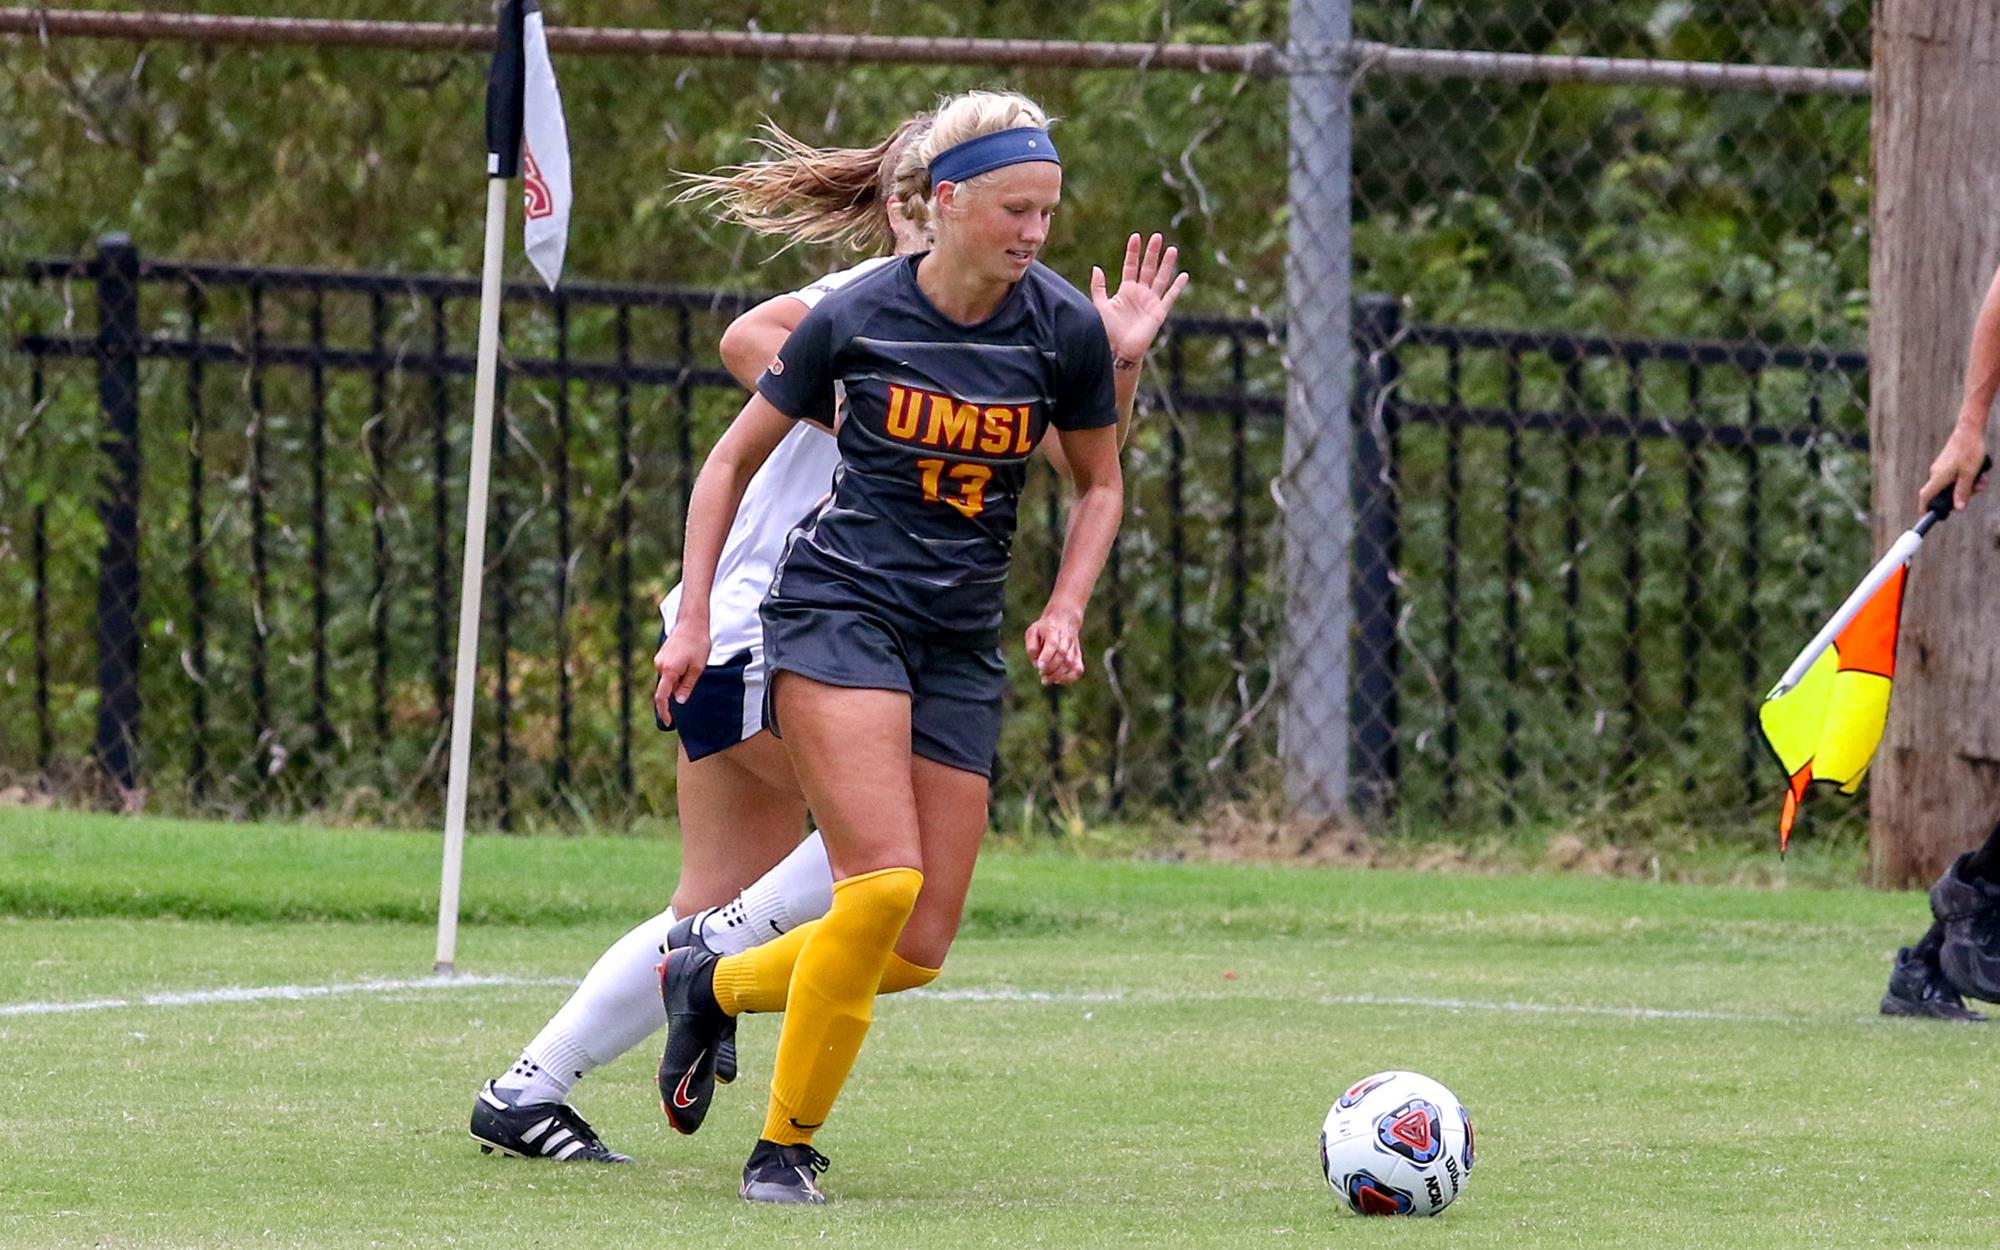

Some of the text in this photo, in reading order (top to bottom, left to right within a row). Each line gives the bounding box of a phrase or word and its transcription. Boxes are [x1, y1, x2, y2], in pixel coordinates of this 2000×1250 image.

[886, 384, 1032, 456] UMSL
[917, 457, 993, 519] 13
[1424, 1175, 1443, 1209] NCAA
